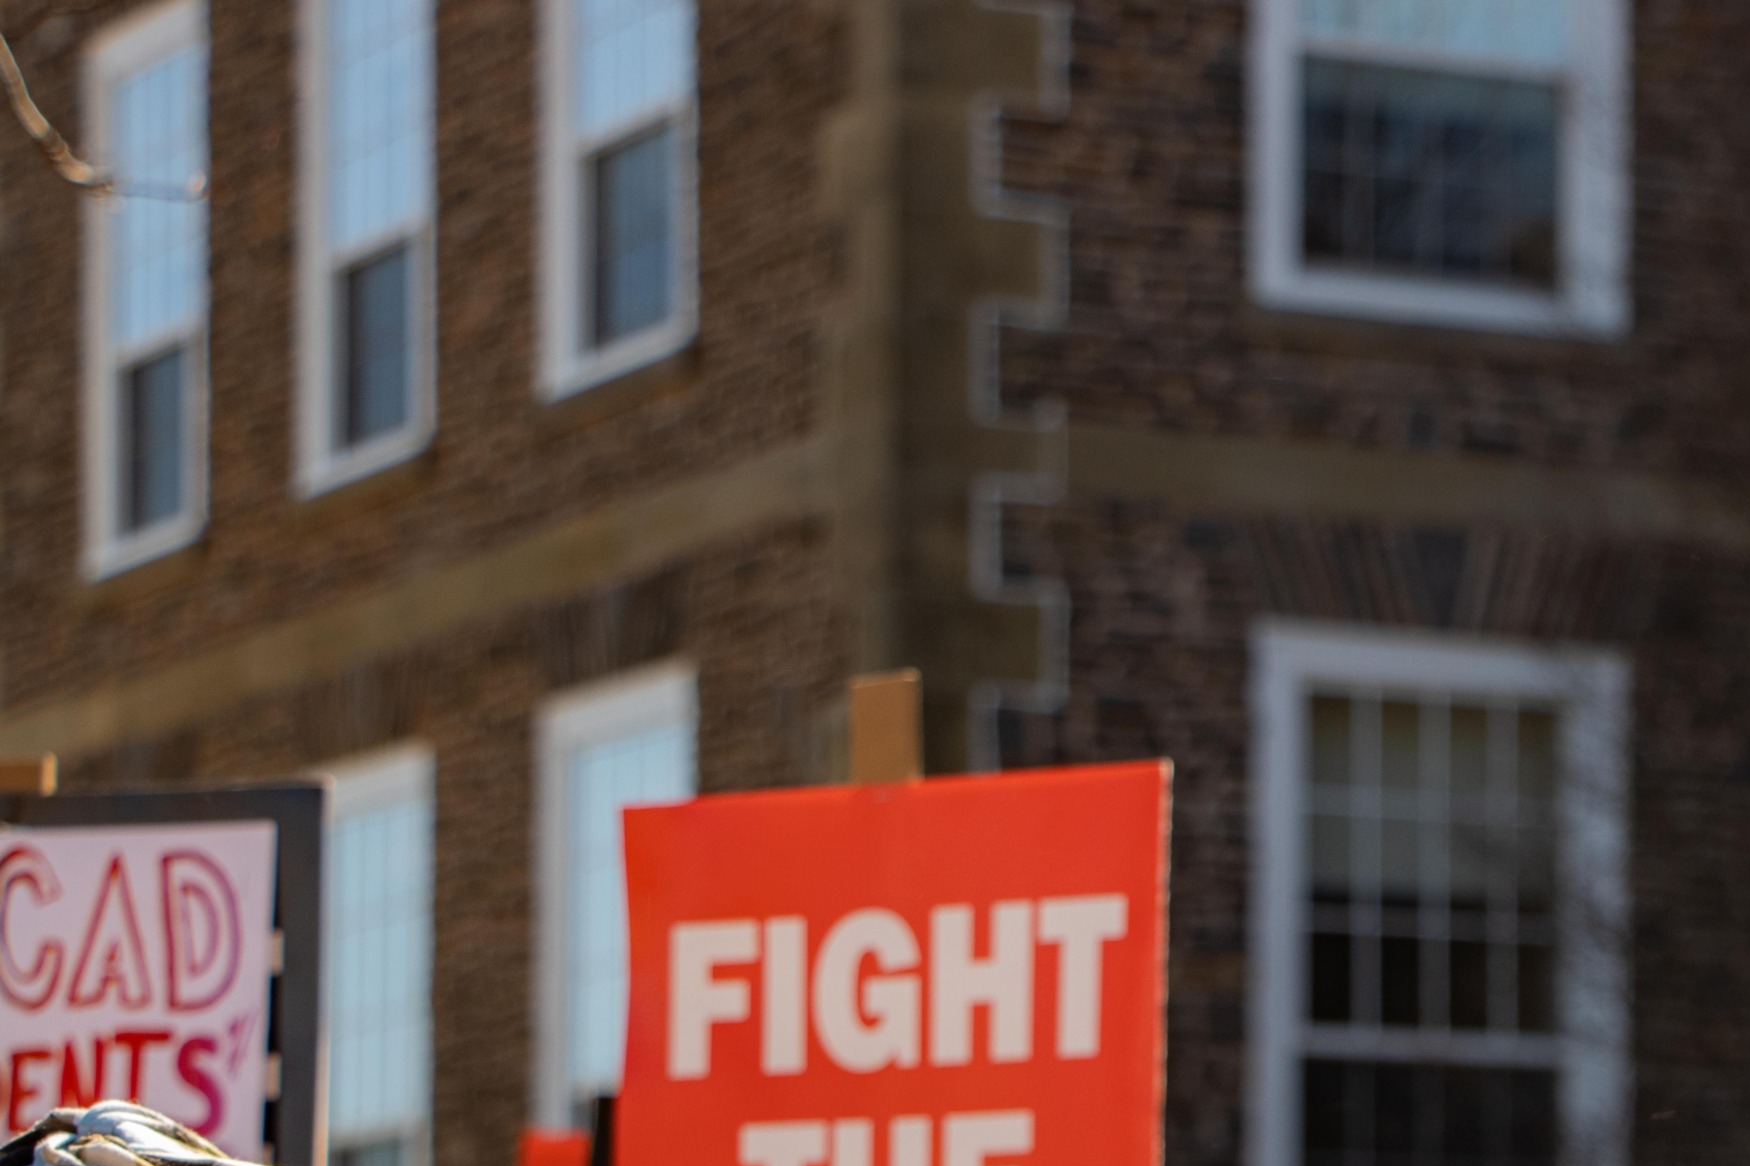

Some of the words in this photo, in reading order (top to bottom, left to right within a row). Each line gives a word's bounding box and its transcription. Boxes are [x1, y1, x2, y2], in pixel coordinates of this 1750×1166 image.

[0, 842, 243, 1014] CAD
[666, 892, 1129, 1081] FIGHT
[0, 1010, 256, 1138] ENTS'
